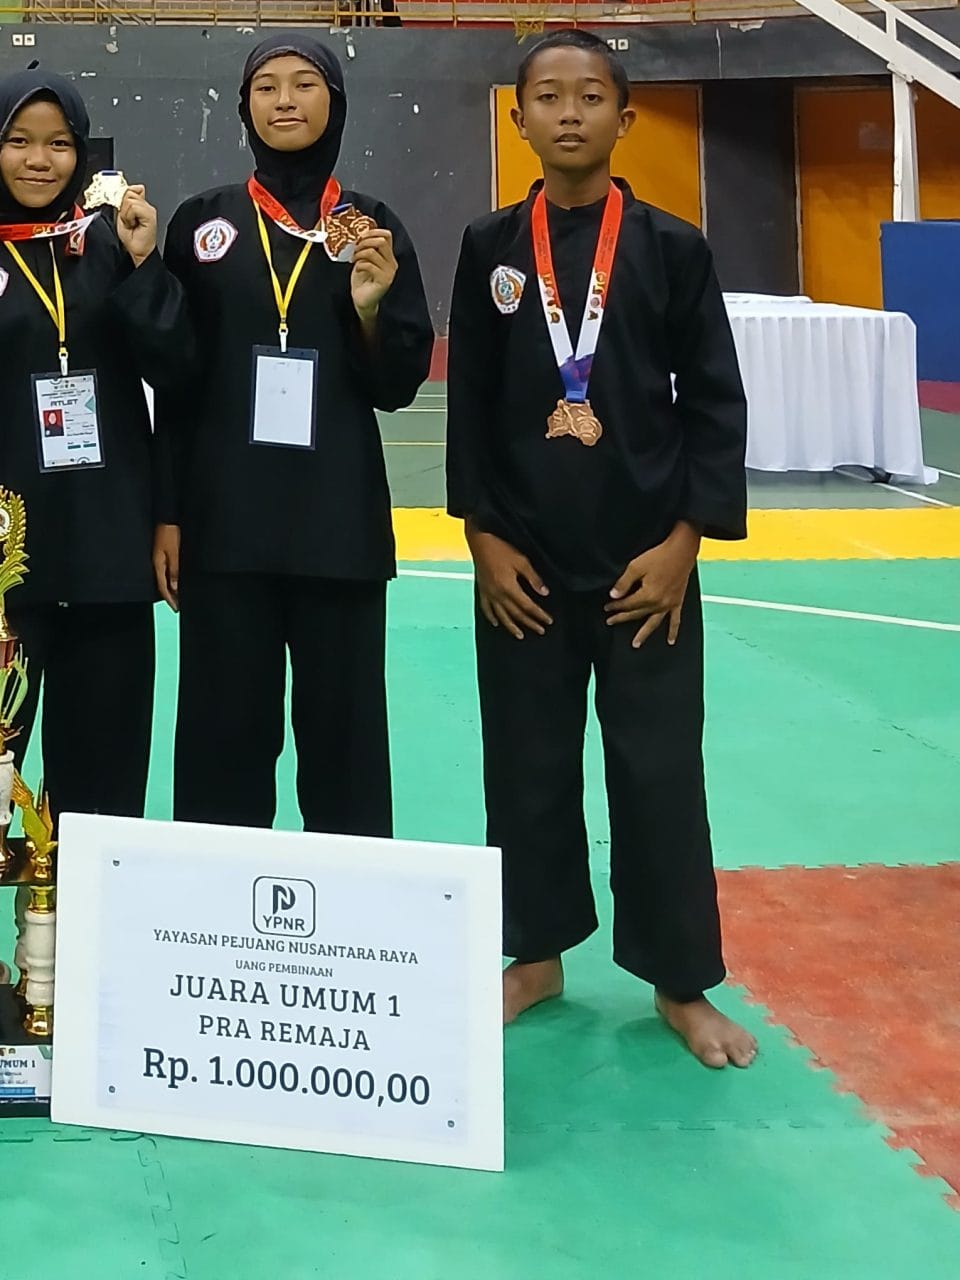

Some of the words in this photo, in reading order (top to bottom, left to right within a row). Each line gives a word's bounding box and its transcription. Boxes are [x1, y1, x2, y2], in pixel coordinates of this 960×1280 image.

[50, 398, 78, 407] ATLET
[262, 914, 306, 932] YPNR
[153, 928, 218, 946] YAYASAN
[221, 934, 286, 953] PEJUANG
[288, 940, 377, 961] NUSANTARA
[379, 949, 419, 965] RAYA
[235, 959, 266, 972] UANG
[268, 962, 333, 978] PEMBINAAN
[169, 974, 270, 1005] JUARA
[279, 984, 377, 1015] UMUM
[388, 994, 401, 1018] 1
[198, 1014, 252, 1040] PRA
[260, 1020, 371, 1051] REMAJA
[31, 1059, 36, 1068] 1
[142, 1047, 198, 1089] Rp.
[209, 1055, 430, 1108] 1.000.000,00
